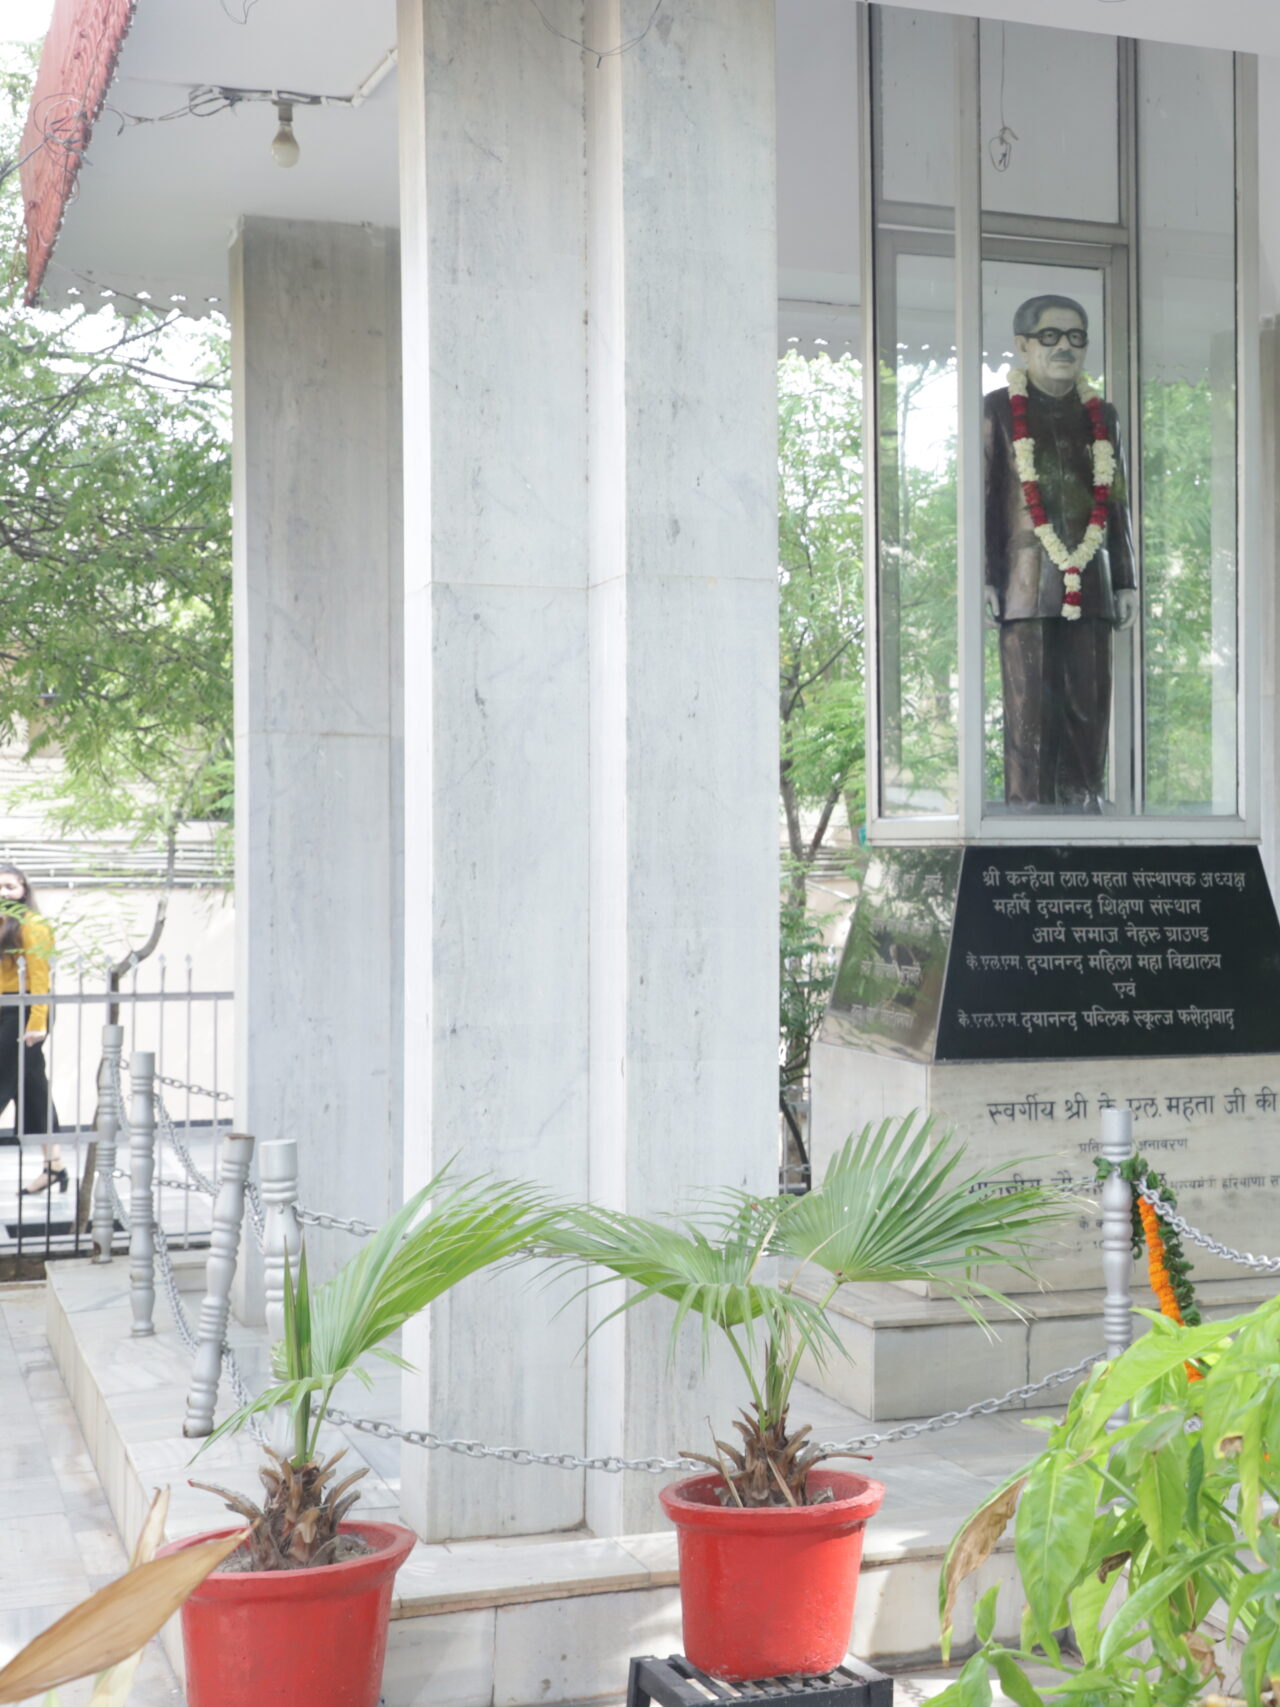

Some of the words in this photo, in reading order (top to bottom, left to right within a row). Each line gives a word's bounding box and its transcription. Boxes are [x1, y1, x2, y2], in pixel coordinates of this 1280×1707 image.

[983, 866, 1000, 886] श्री
[1005, 865, 1055, 890] कन्हैया
[1060, 872, 1089, 887] लाल
[1132, 868, 1196, 888] संस्थापक
[1200, 872, 1245, 891] अध्यक्ष
[992, 892, 1031, 917] महर्षि
[1036, 899, 1093, 919] दयानन्द
[1097, 894, 1144, 919] शिक्षण
[1149, 896, 1201, 915] संस्थान
[1032, 921, 1065, 943] आर्य
[1071, 927, 1118, 943] समाज
[1164, 927, 1209, 942] ग्राउण्ड
[1025, 955, 1083, 975] दयानन्द
[1088, 949, 1132, 974] महिला
[1136, 955, 1162, 974] महा
[1166, 949, 1221, 969] विद्यालय
[1112, 978, 1136, 999] एवं
[1021, 1012, 1077, 1033] दयानन्द
[1081, 1006, 1130, 1026] पब्लिक
[1177, 1007, 1234, 1030] फरीदाबाद
[986, 1092, 1057, 1125] स्वर्गीय
[1064, 1091, 1089, 1120] श्री
[1223, 1086, 1247, 1115] जी
[1254, 1085, 1278, 1112] की
[1138, 1136, 1189, 1152] अनावरण
